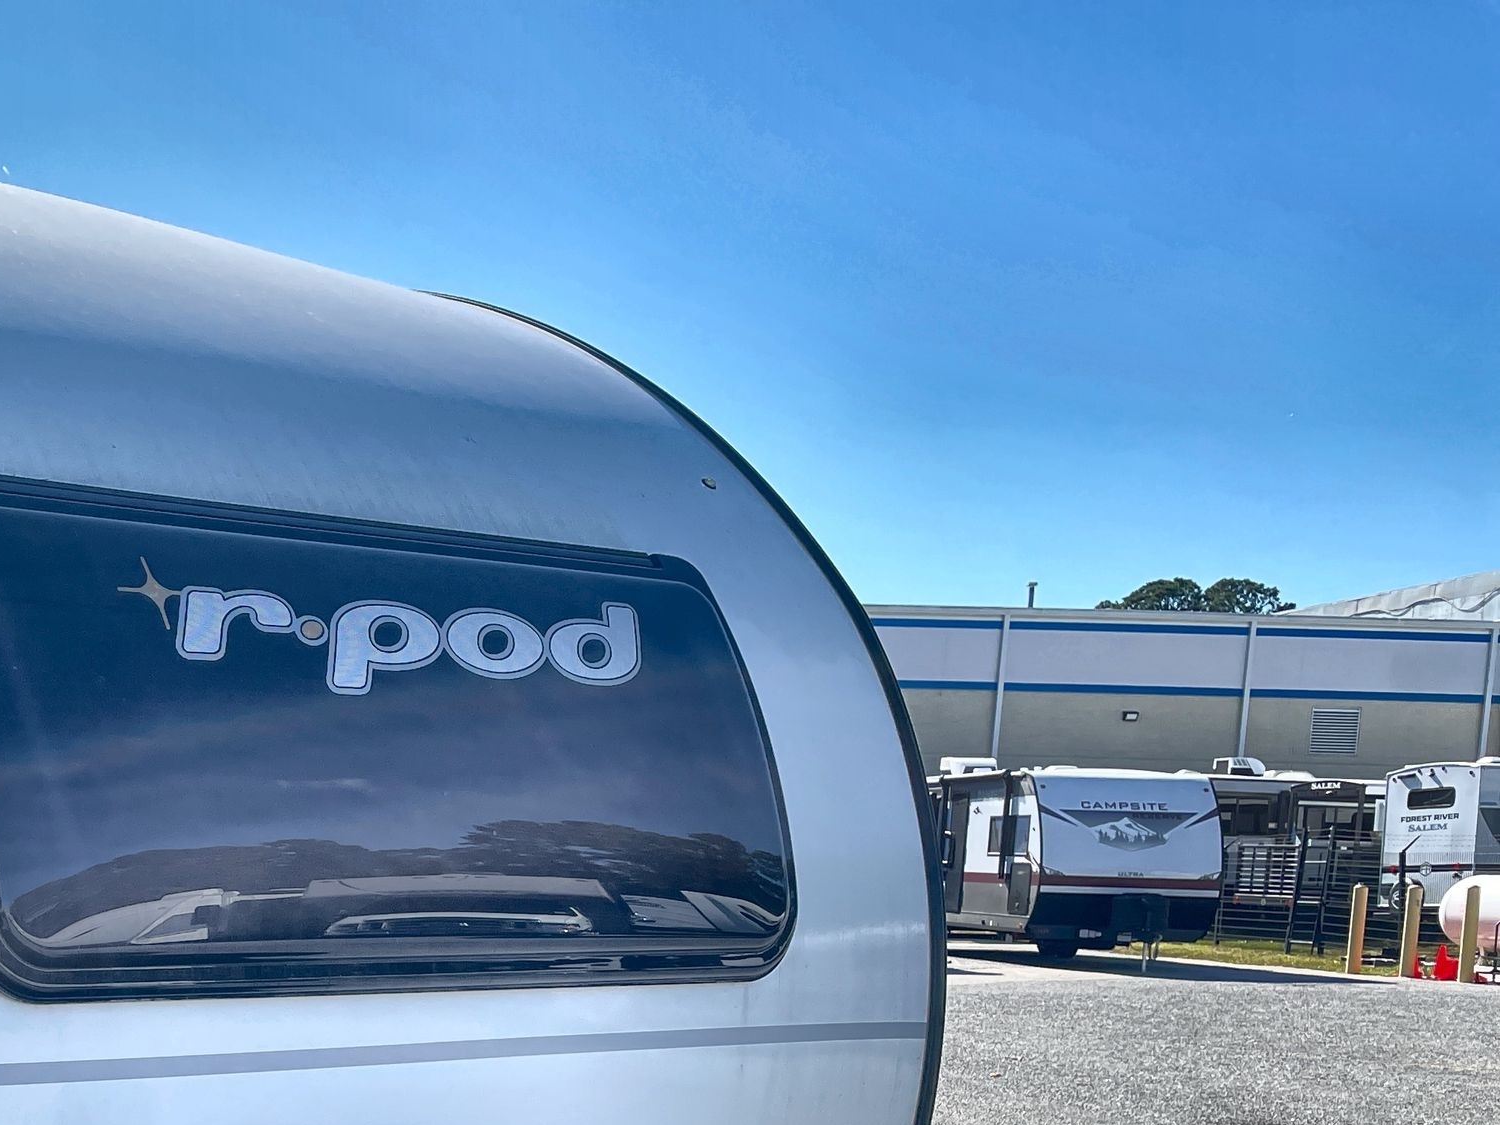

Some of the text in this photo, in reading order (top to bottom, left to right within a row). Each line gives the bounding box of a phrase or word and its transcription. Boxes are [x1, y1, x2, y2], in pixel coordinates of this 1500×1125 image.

[1311, 782, 1341, 791] SALEM
[1080, 800, 1169, 811] CAMPSITE
[1400, 812, 1460, 823] FOREST RIVER
[1408, 822, 1448, 833] SALEM
